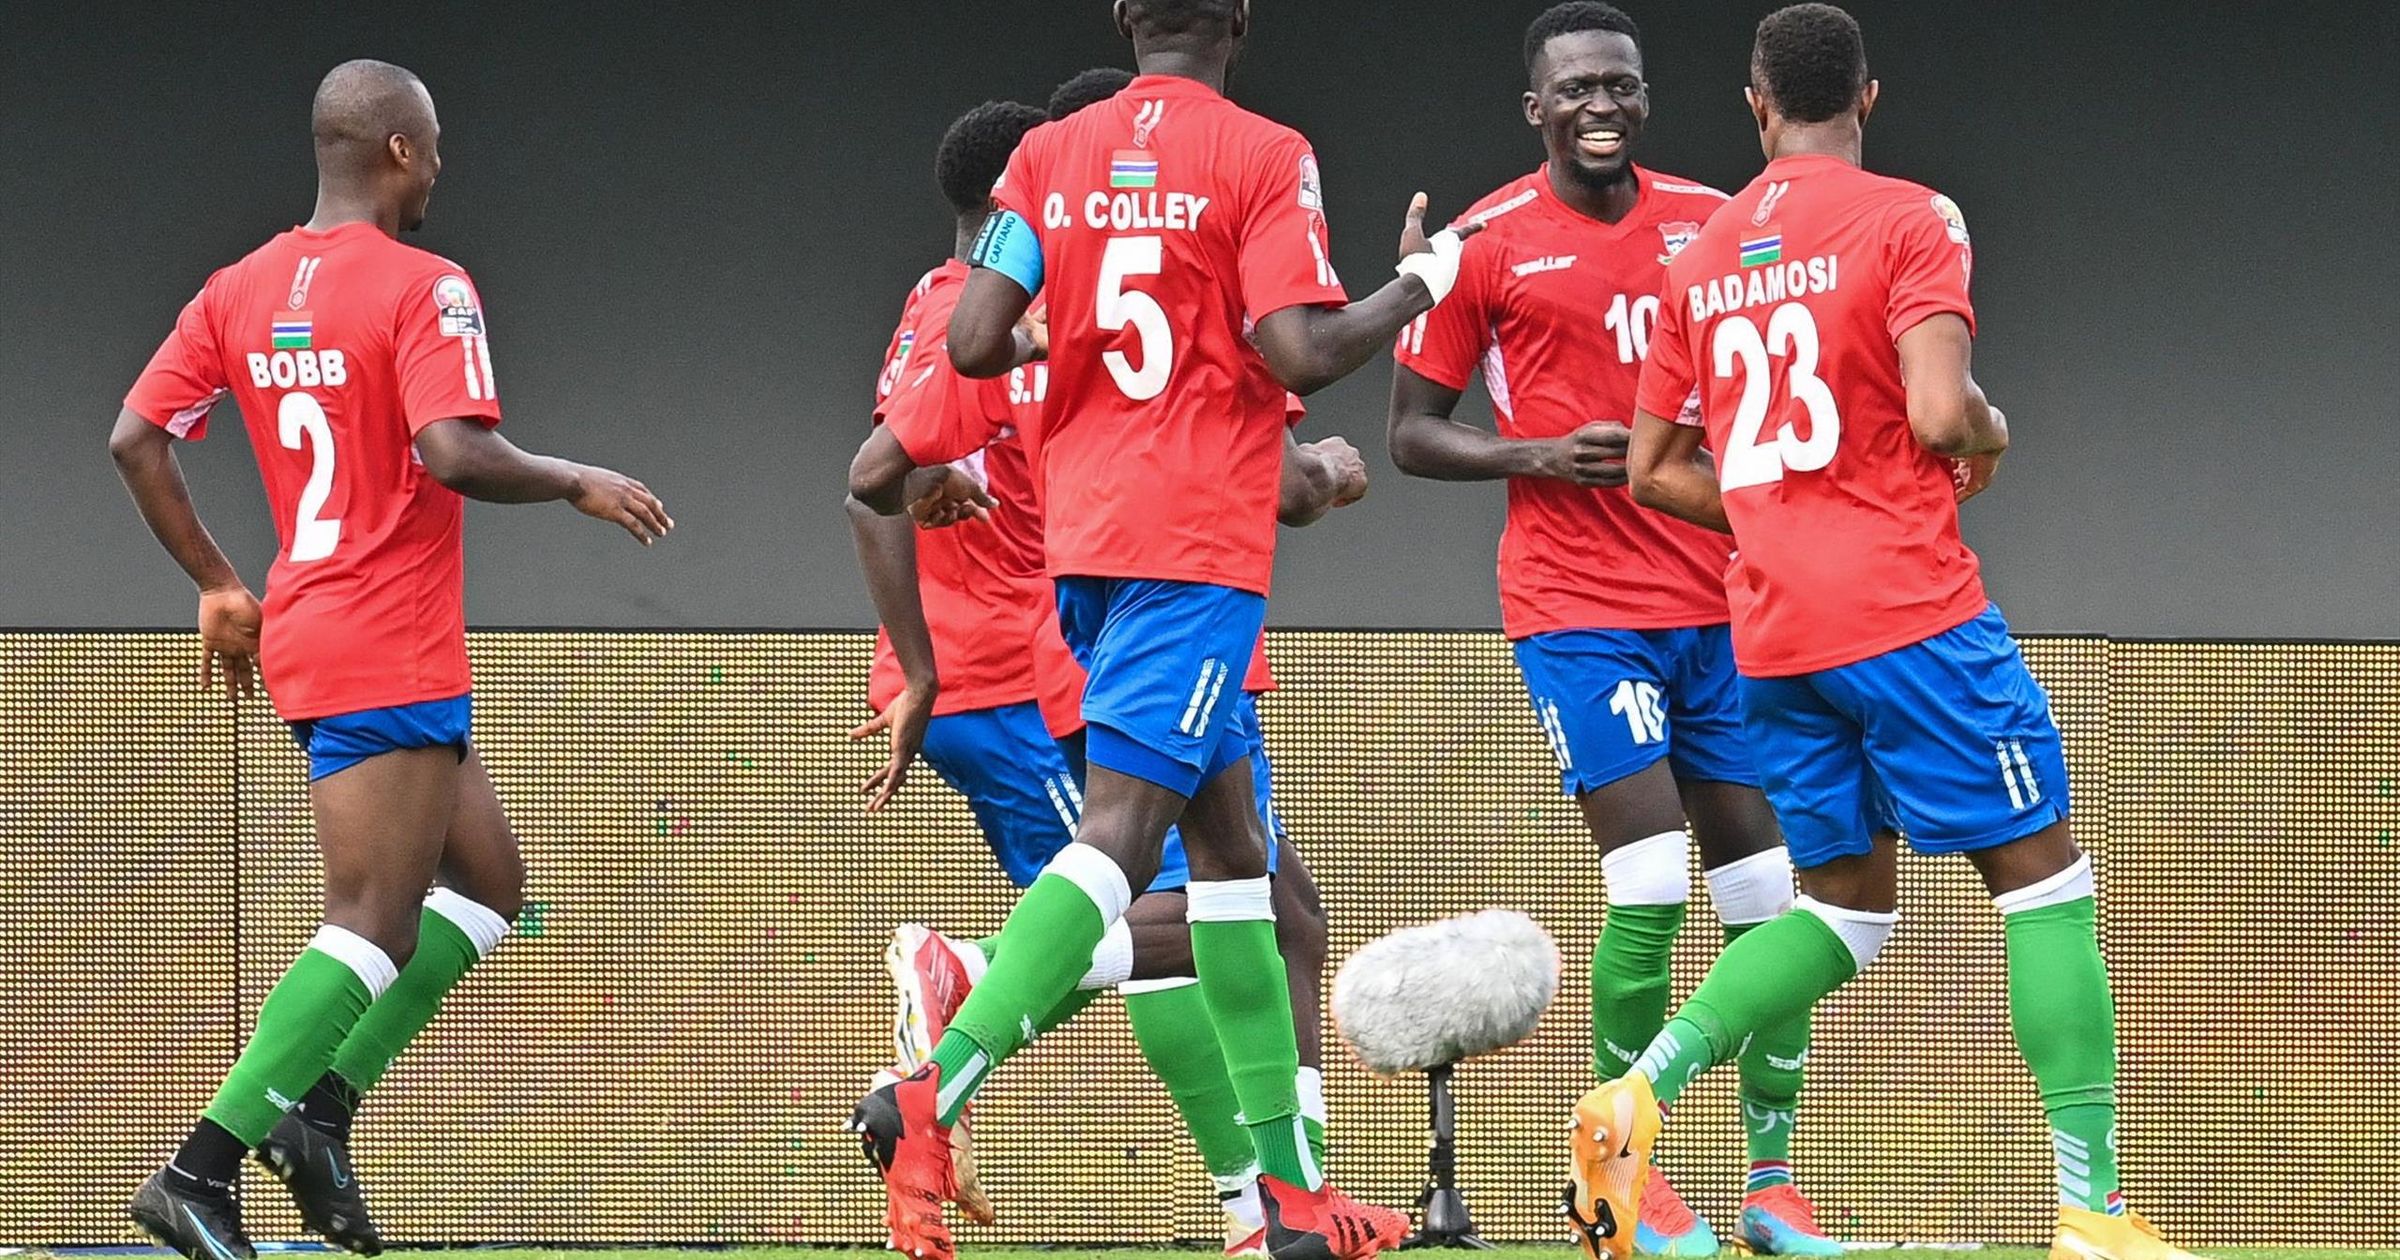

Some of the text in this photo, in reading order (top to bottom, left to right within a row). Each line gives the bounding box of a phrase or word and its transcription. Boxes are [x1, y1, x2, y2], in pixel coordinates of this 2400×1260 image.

[989, 215, 1017, 265] CAPITANO
[1043, 192, 1210, 232] O. COLLEY
[1096, 235, 1174, 400] 5
[1687, 254, 1838, 323] BADAMOSI
[1604, 293, 1660, 364] 10
[246, 349, 347, 389] BOBB
[1713, 302, 1841, 493] 23
[277, 391, 342, 563] 2
[1609, 680, 1666, 744] 10
